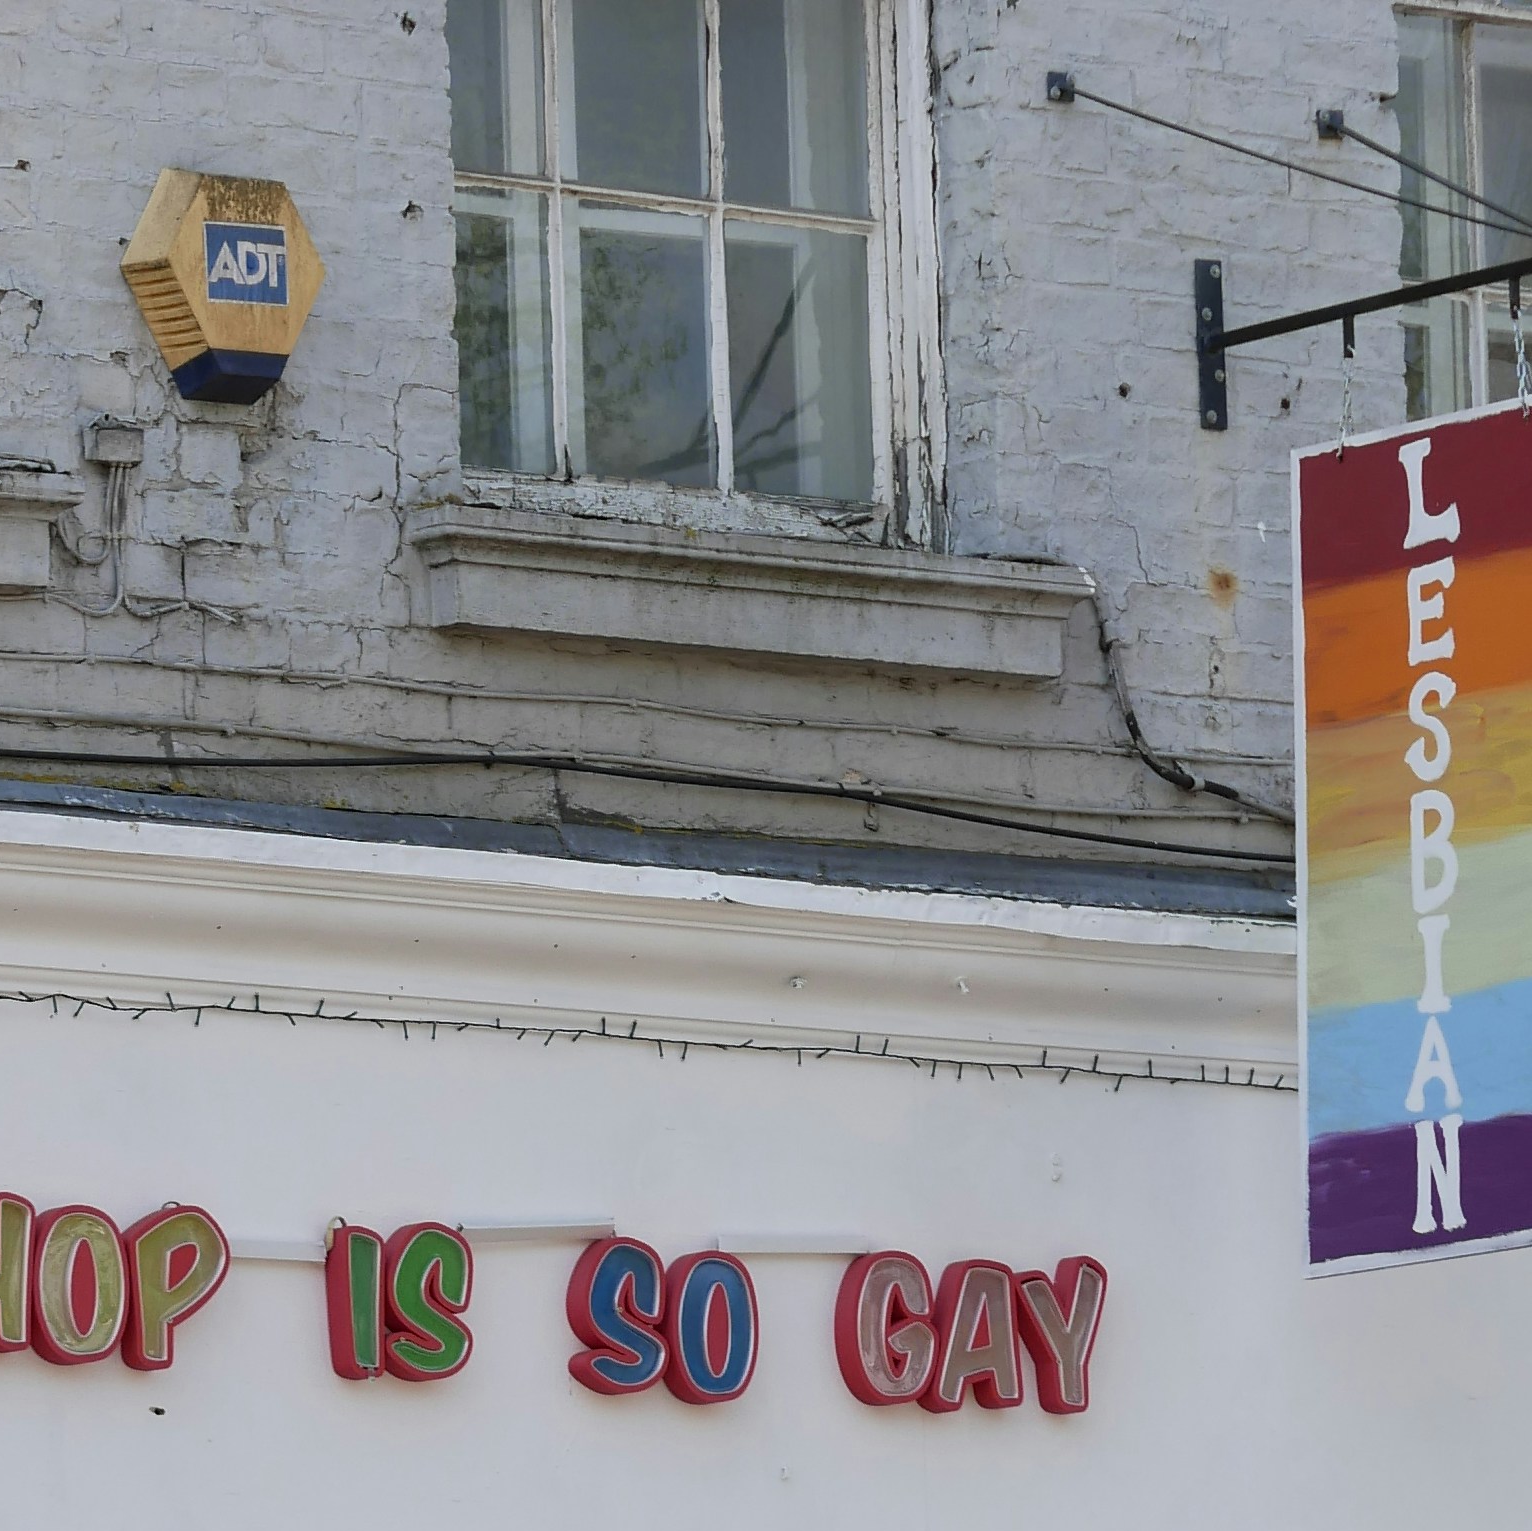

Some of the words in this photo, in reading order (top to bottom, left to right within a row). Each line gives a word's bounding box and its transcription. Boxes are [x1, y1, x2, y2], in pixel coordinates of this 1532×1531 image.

[208, 240, 287, 288] ADT
[1397, 437, 1467, 1236] LESBIAN
[326, 1221, 474, 1383] IS
[566, 1235, 760, 1406] SO
[833, 1250, 1109, 1415] GAY
